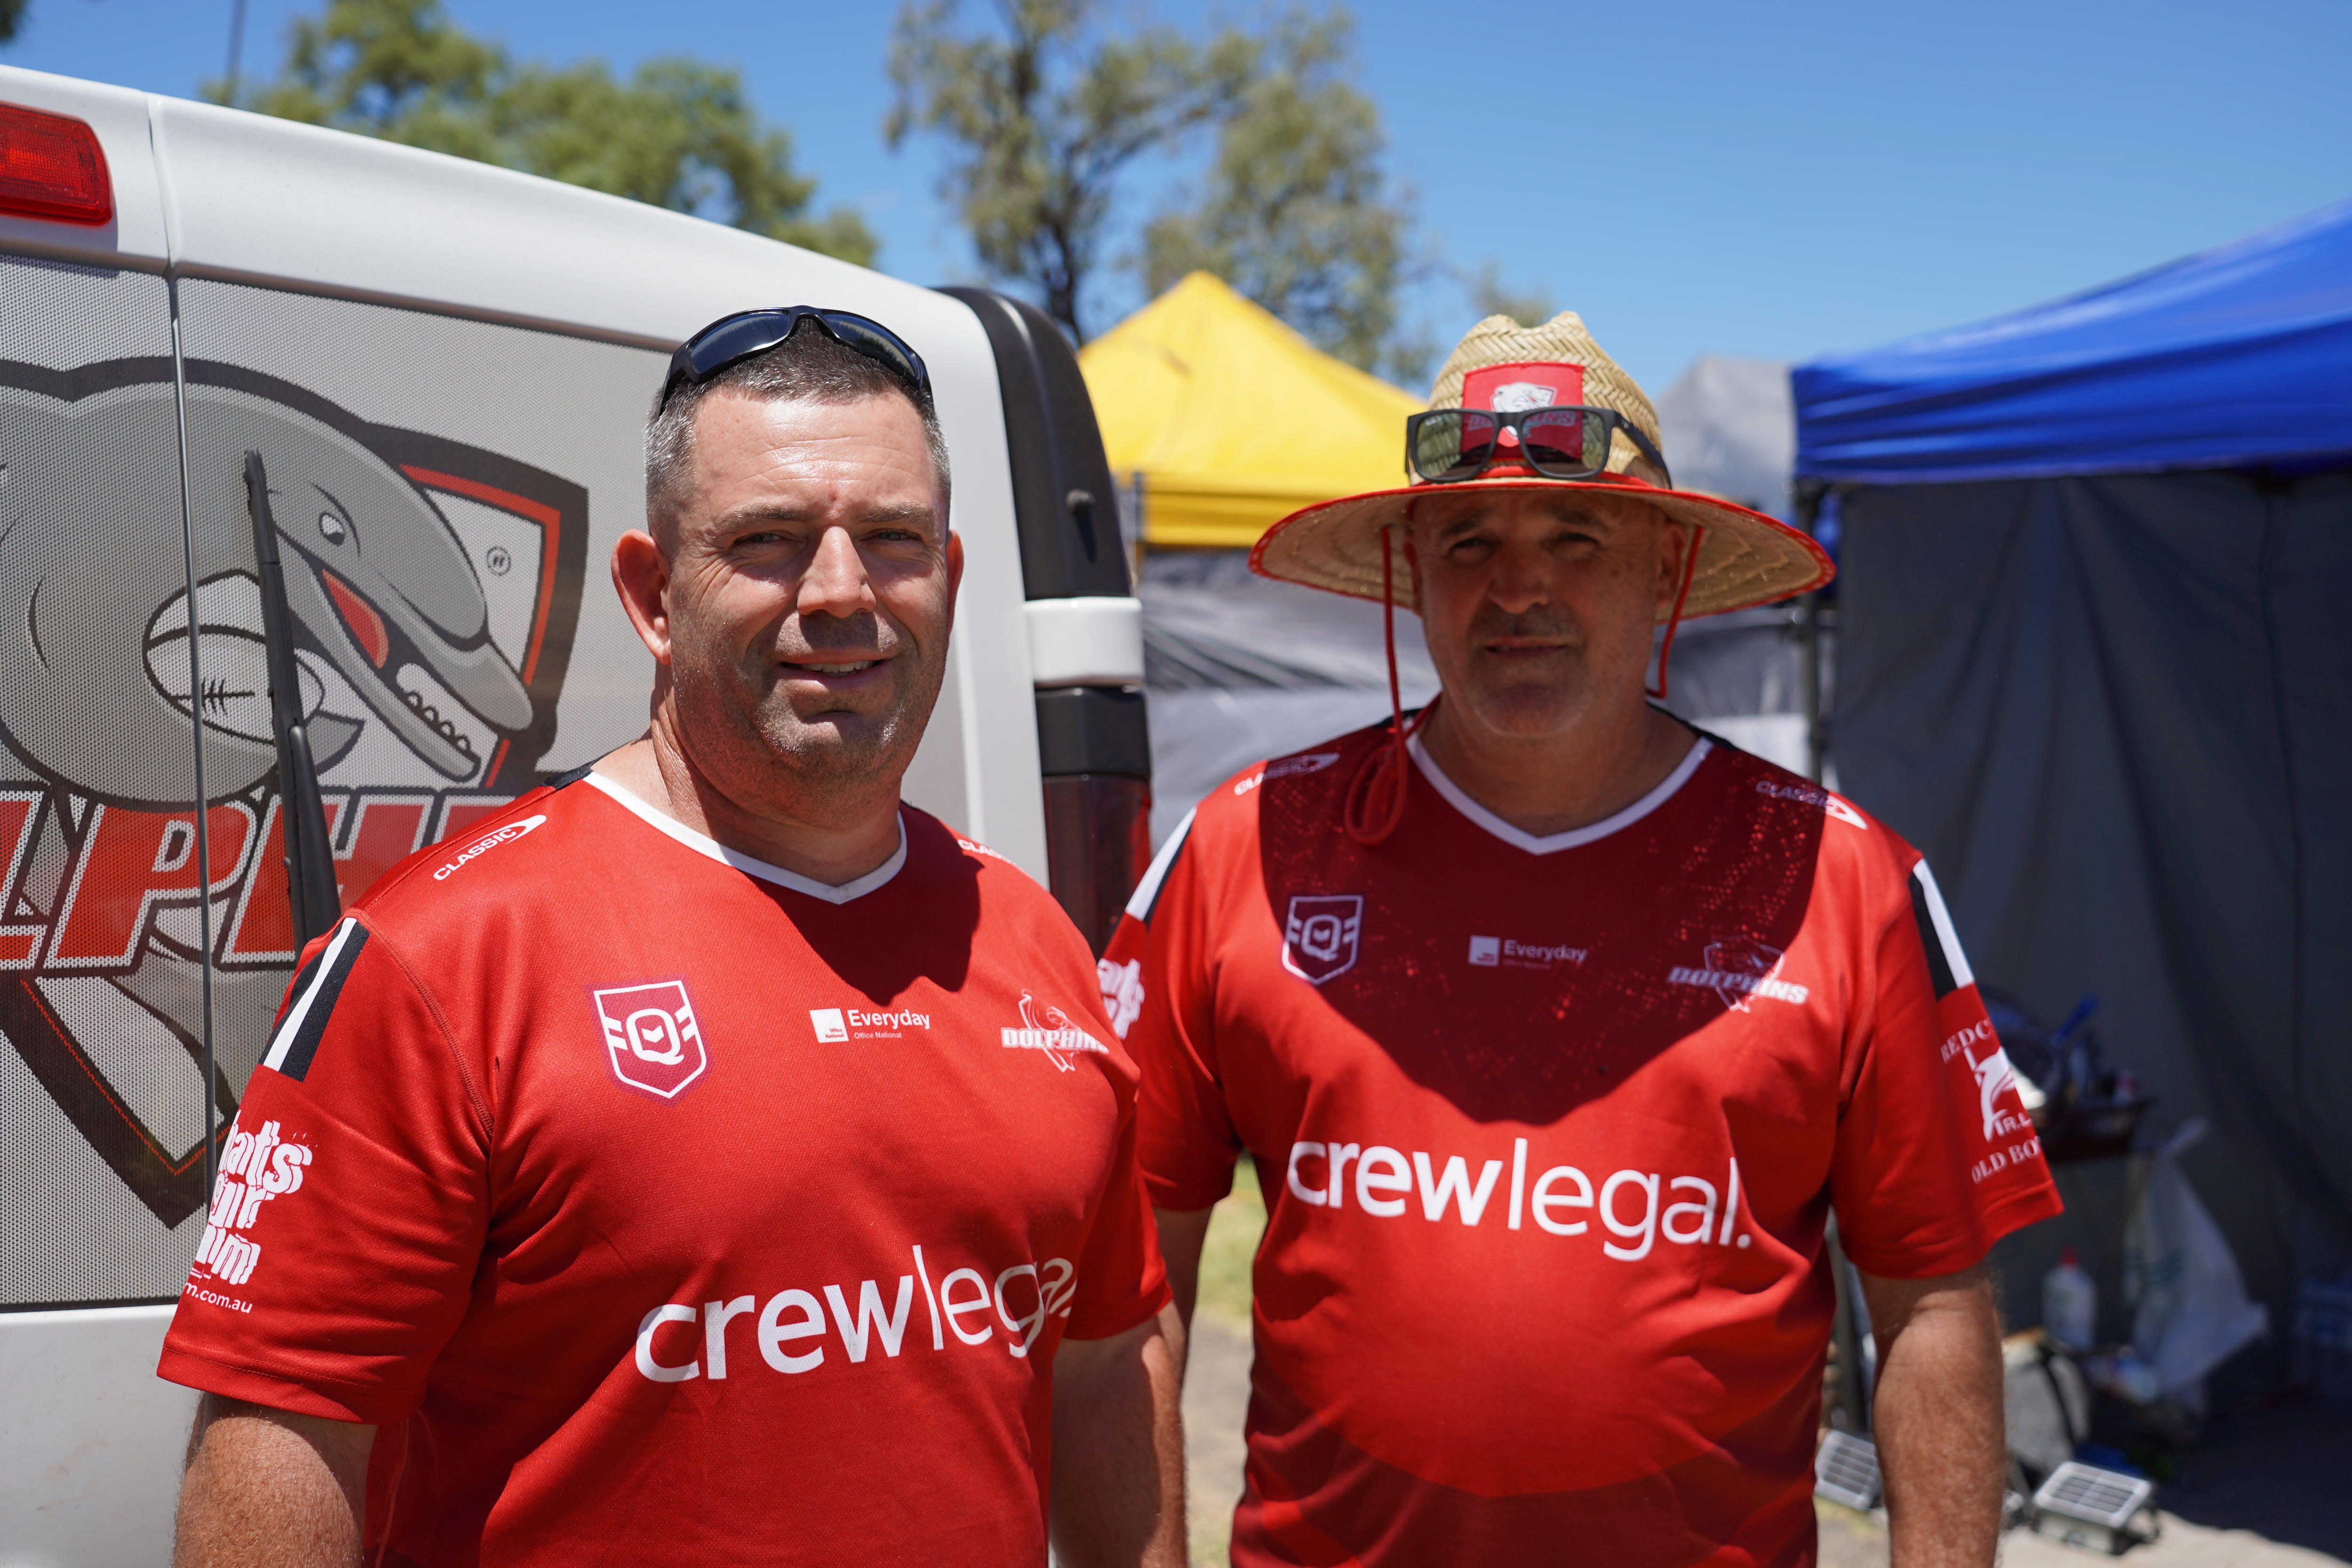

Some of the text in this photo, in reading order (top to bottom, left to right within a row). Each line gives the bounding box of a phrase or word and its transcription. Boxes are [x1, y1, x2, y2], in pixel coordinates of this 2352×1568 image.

[433, 827, 517, 880] CLASSIC
[1504, 939, 1588, 963] Everyday
[1667, 965, 1809, 1005] DOLPHINS
[847, 1009, 930, 1030] Everyday
[1940, 1019, 1991, 1064] REDC
[1971, 1152, 2007, 1185] OLD
